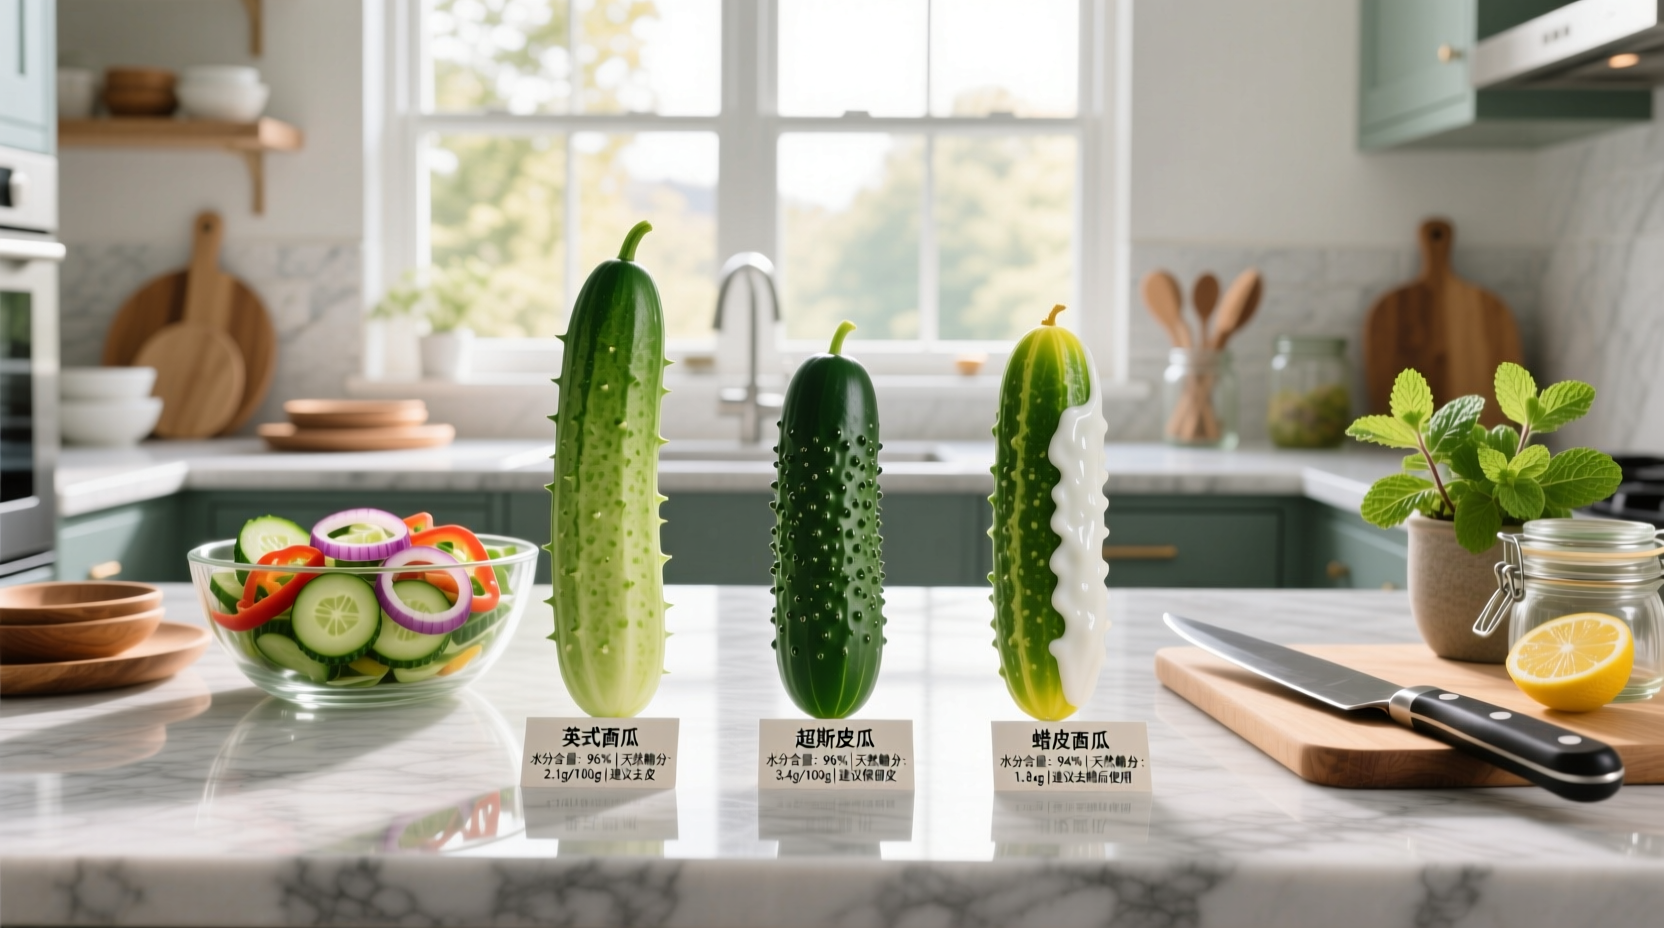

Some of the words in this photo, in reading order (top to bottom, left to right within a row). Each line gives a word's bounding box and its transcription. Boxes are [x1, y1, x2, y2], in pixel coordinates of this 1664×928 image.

[587, 754, 611, 764] 96%
[823, 755, 847, 766] 96%
[544, 768, 602, 783] 2.1g/100g
